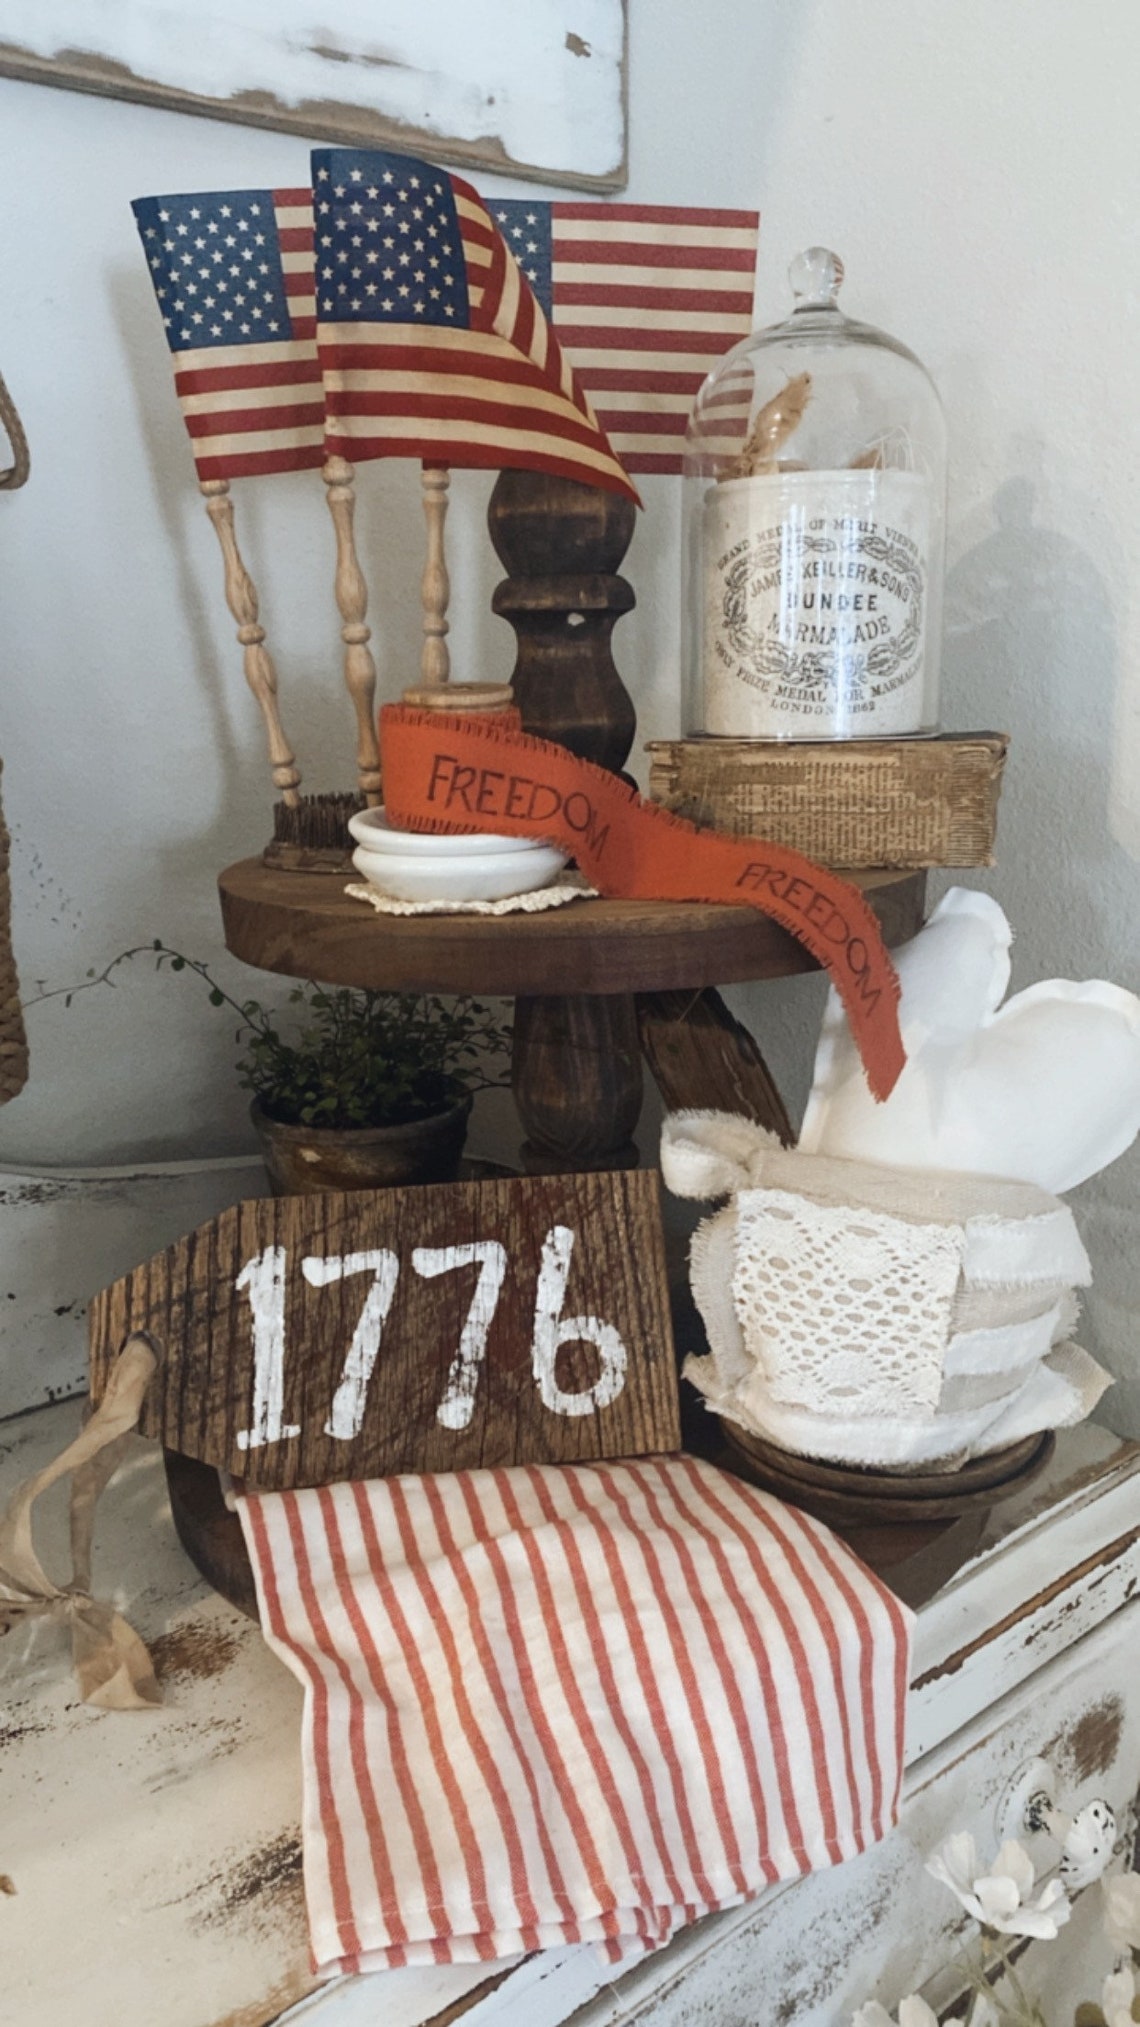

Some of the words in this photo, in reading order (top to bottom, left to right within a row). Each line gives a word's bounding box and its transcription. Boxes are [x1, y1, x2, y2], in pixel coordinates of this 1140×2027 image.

[808, 518, 825, 531] OF
[787, 593, 878, 611] DUNDEE
[775, 684, 828, 702] MEDAL
[427, 754, 611, 863] FREEDOM
[735, 863, 883, 1018] FREEDOM
[235, 1224, 628, 1451] 1776
